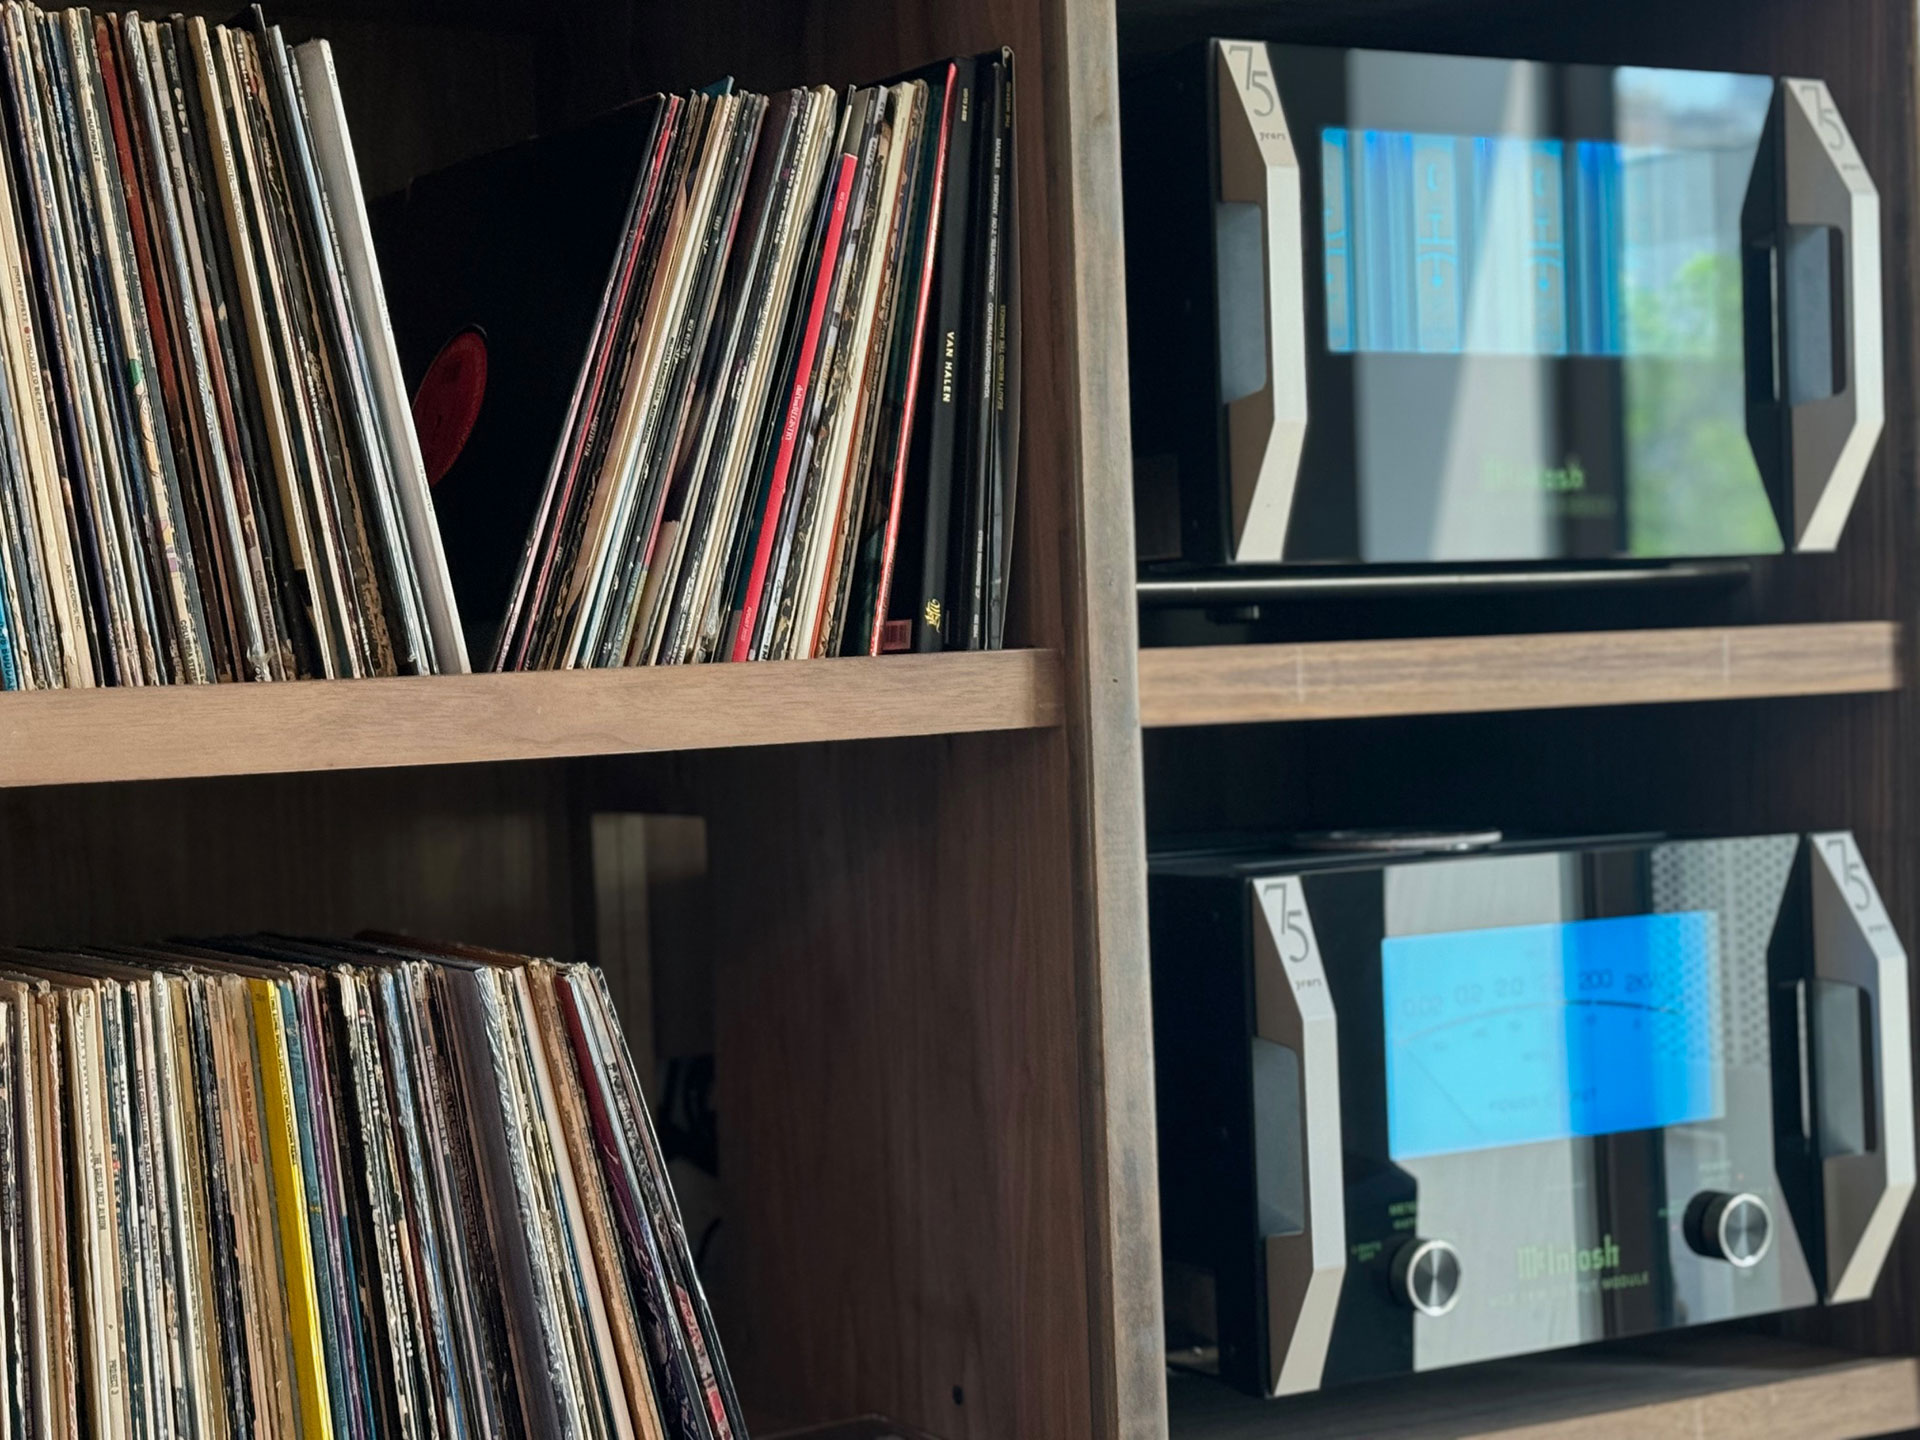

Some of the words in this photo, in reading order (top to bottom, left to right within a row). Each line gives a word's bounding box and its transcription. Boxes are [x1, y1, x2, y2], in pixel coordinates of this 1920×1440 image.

[1228, 45, 1274, 117] 75
[1801, 84, 1845, 151] 75
[1259, 131, 1286, 141] years
[991, 174, 999, 214] SYMPHONY
[12, 265, 22, 288] JIMMY
[16, 290, 29, 323] BUFFETT
[945, 331, 955, 357] VAN
[942, 361, 953, 402] HALEN
[64, 563, 73, 579] ABC
[1825, 838, 1871, 911] 75
[1263, 882, 1310, 964] 75
[1578, 968, 1614, 991] 200
[360, 1026, 373, 1070] THOMPSON
[368, 1073, 377, 1099] TWINS
[136, 1069, 144, 1089] ELVIS
[424, 1045, 433, 1060] LOU
[435, 1103, 446, 1128] THINGS
[137, 1091, 148, 1128] COSTELLO
[141, 1130, 150, 1144] AND
[93, 1153, 101, 1165] THE
[93, 1167, 103, 1189] GREAT
[144, 1160, 154, 1209] ATTRACTIONS
[95, 1190, 104, 1206] JAZZ
[96, 1207, 106, 1230] ALBUM
[149, 1225, 157, 1249] PUNCH
[153, 1267, 161, 1290] CLOCK
[107, 1359, 118, 1387] PROJECT
